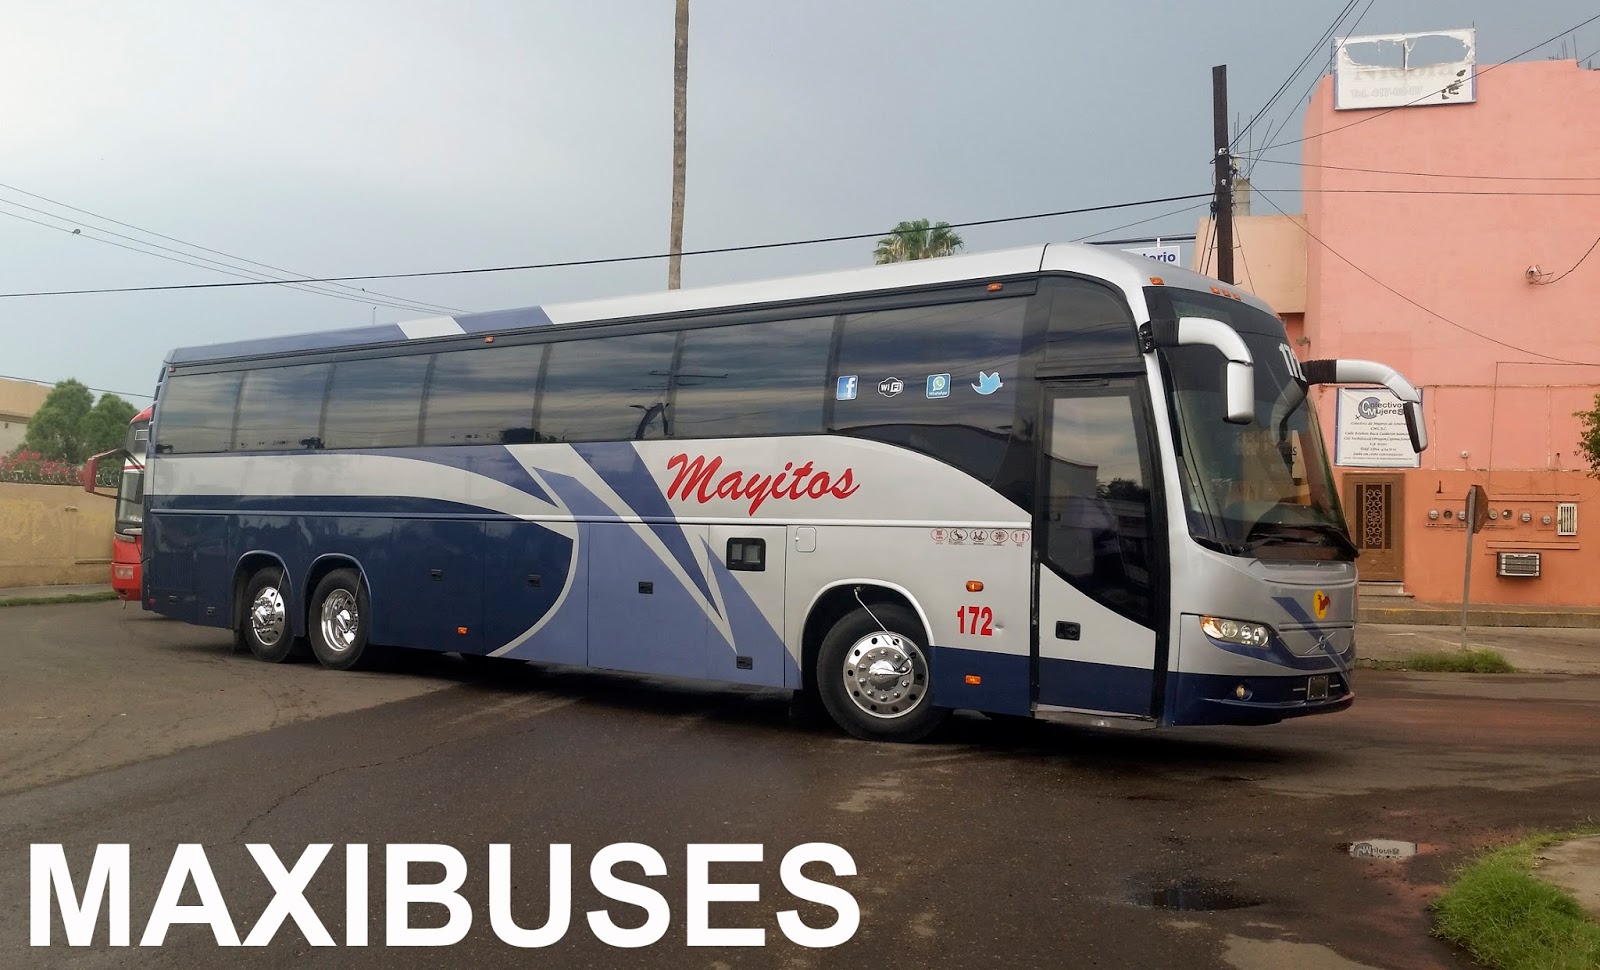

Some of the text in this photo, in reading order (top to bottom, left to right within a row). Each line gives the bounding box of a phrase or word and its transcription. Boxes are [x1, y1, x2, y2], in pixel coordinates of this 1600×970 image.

[1362, 400, 1402, 413] Colectivo
[667, 453, 860, 516] Mayitos
[957, 605, 993, 636] 172
